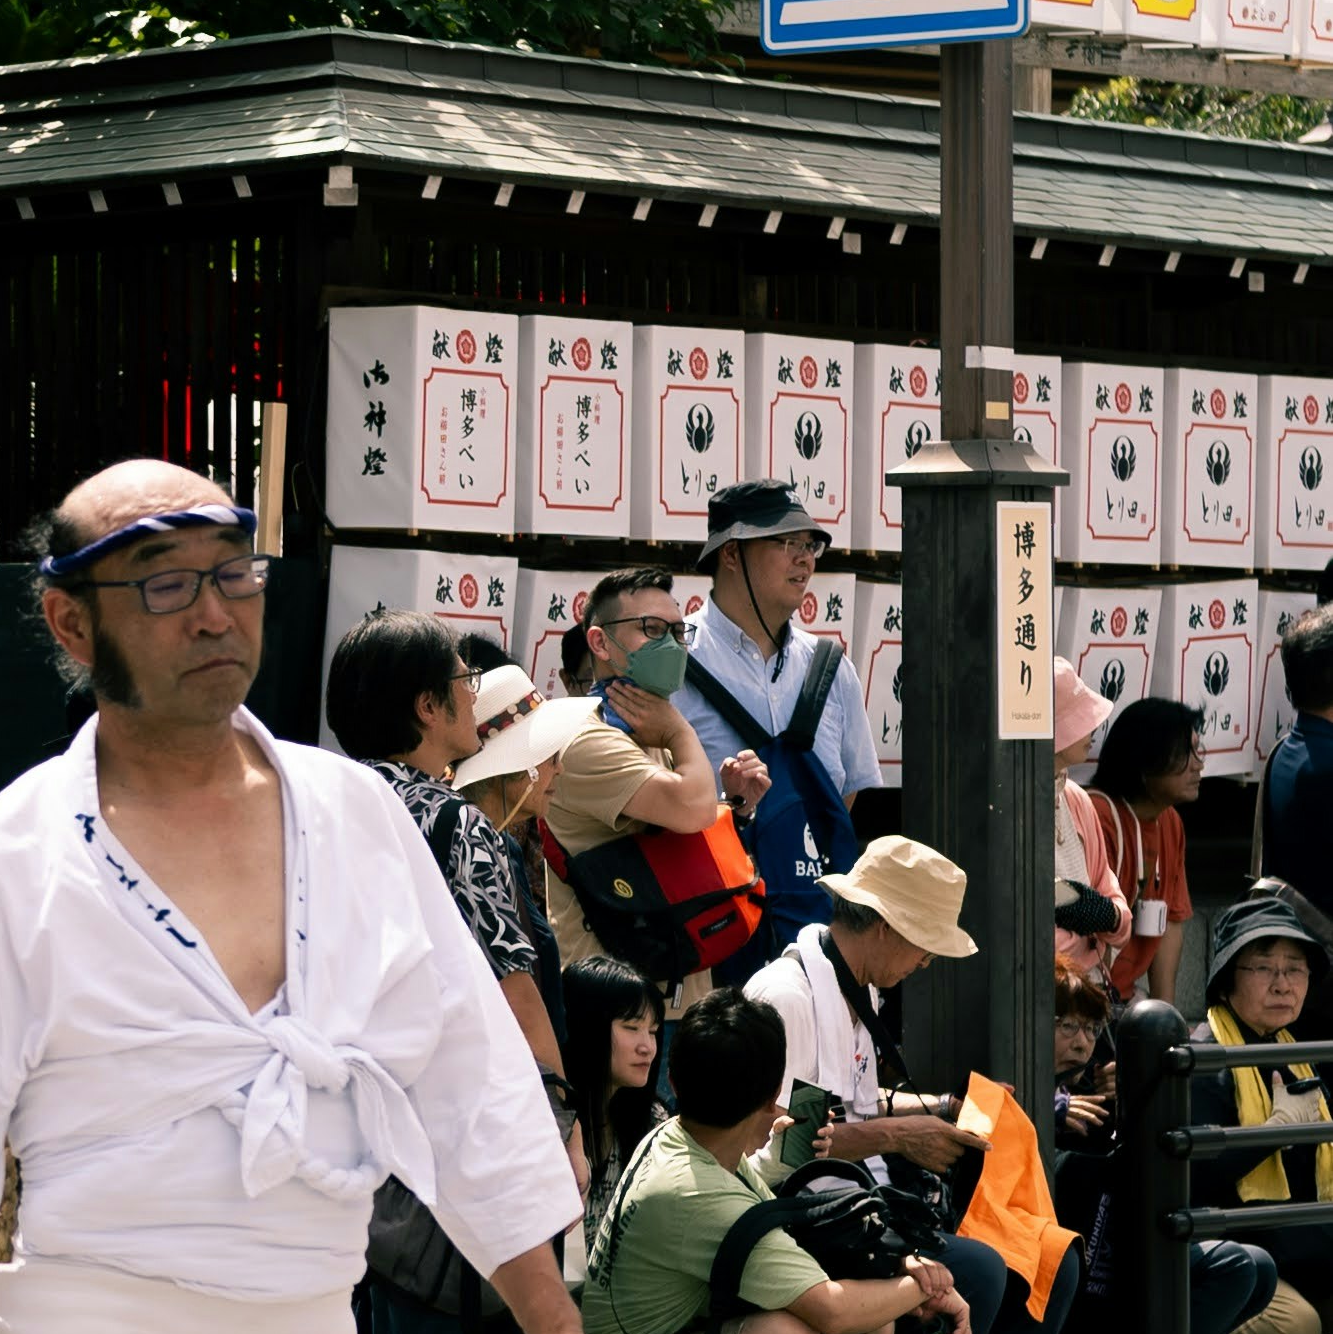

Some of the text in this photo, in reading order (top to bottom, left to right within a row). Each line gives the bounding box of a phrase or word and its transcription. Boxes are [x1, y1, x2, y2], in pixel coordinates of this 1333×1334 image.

[459, 388, 477, 489] 博多べい
[575, 394, 592, 494] 博多べい
[1013, 521, 1037, 696] 博多通り
